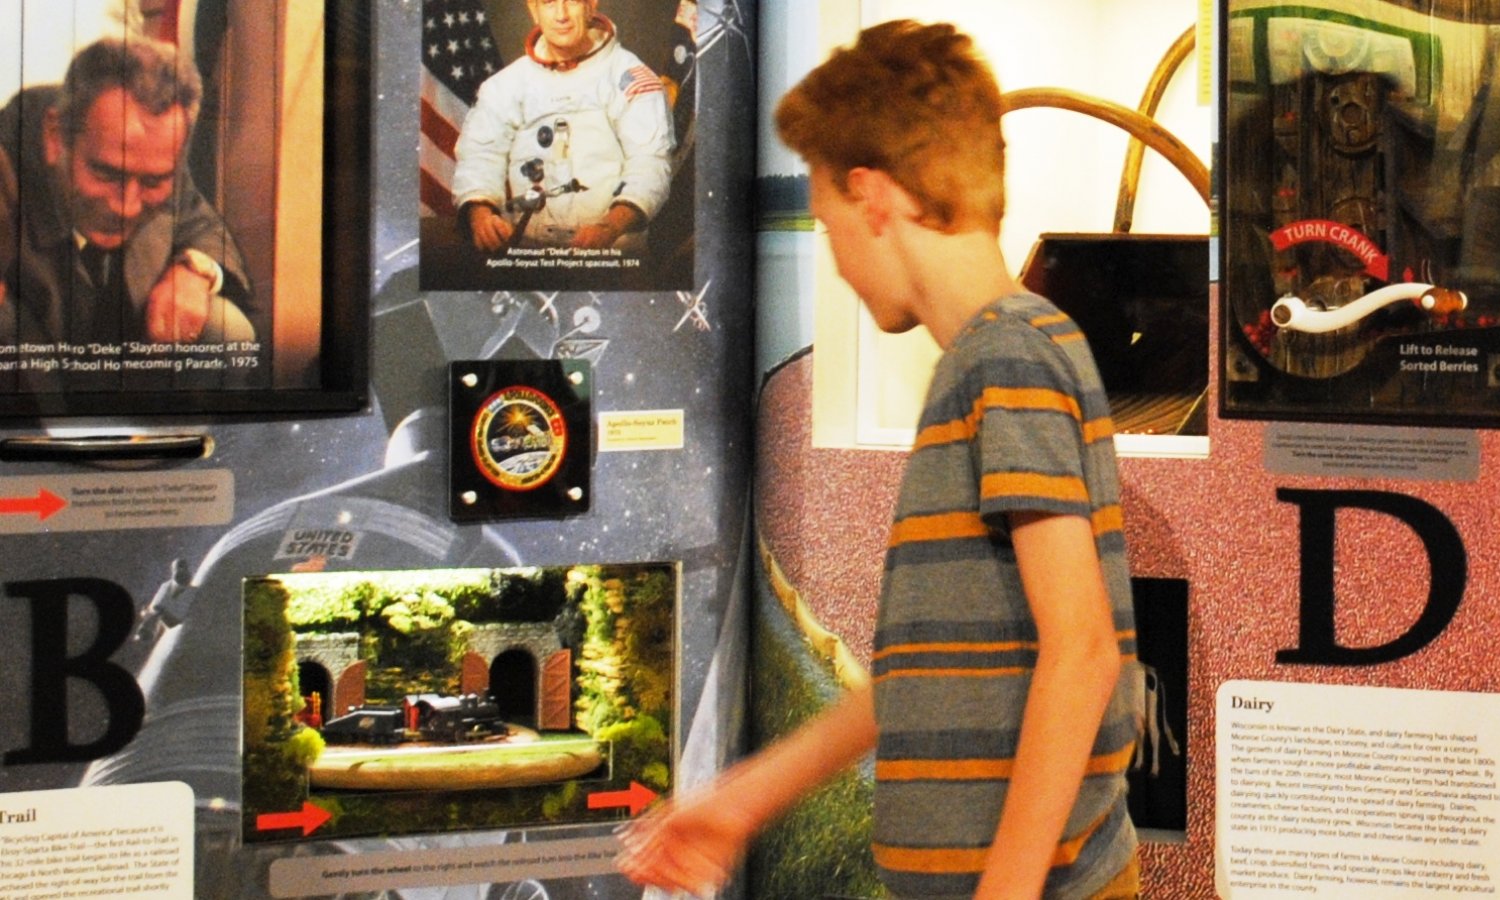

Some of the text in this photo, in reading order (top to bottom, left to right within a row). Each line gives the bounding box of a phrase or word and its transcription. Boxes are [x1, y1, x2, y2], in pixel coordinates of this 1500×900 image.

[1283, 223, 1377, 265] TURN CRANK
[507, 247, 545, 256] Astronaut
[573, 247, 600, 257] Slayton
[602, 247, 609, 255] in
[610, 247, 621, 255] his
[486, 258, 538, 268] Apollo-Soyuz
[540, 258, 555, 267] Test
[557, 258, 583, 268] Project
[129, 342, 173, 355] Slayton
[226, 342, 238, 352] at
[241, 341, 260, 352] the
[1399, 344, 1478, 357] Lift to Release
[31, 358, 60, 373] High
[231, 356, 259, 368] 1975
[1399, 360, 1479, 374] Sorted Berries
[293, 530, 353, 542] UNITED
[285, 542, 352, 556] STATES
[1275, 486, 1468, 666] D
[3, 577, 147, 766] B
[1231, 696, 1274, 713] Dairy
[0, 808, 37, 824] Trail
